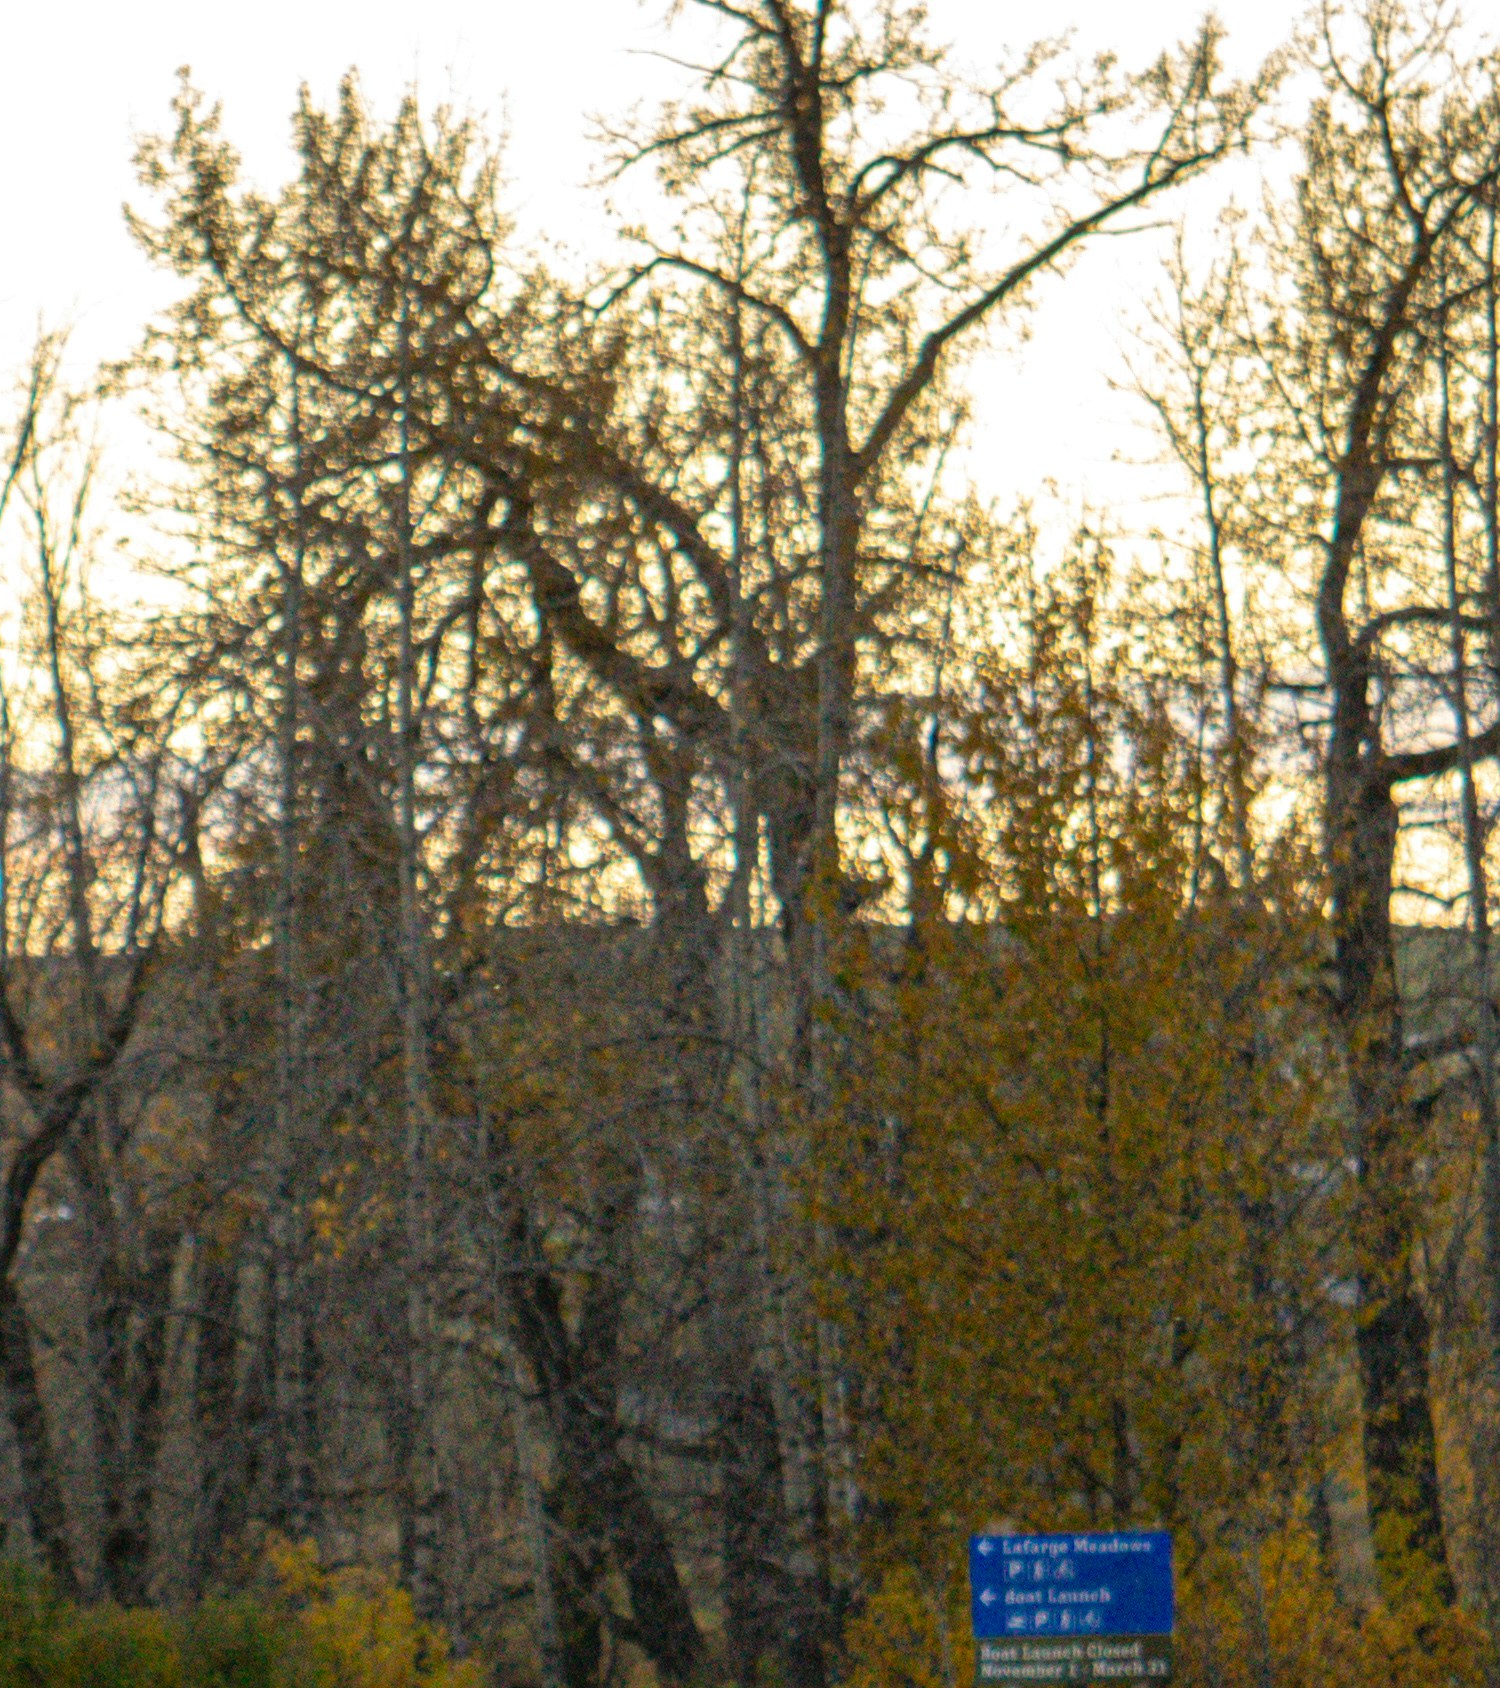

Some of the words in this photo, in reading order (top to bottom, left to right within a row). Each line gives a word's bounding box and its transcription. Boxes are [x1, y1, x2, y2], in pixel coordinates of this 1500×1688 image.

[1002, 1538, 1069, 1558] Lafarge
[1073, 1537, 1152, 1553] Meadows
[1004, 1588, 1042, 1605] Boat
[1048, 1587, 1112, 1604] Launch
[980, 1643, 1018, 1662] Boat
[1021, 1642, 1084, 1661] Launch
[1086, 1641, 1142, 1659] Closed
[980, 1662, 1063, 1678] November
[1092, 1660, 1144, 1677] March
